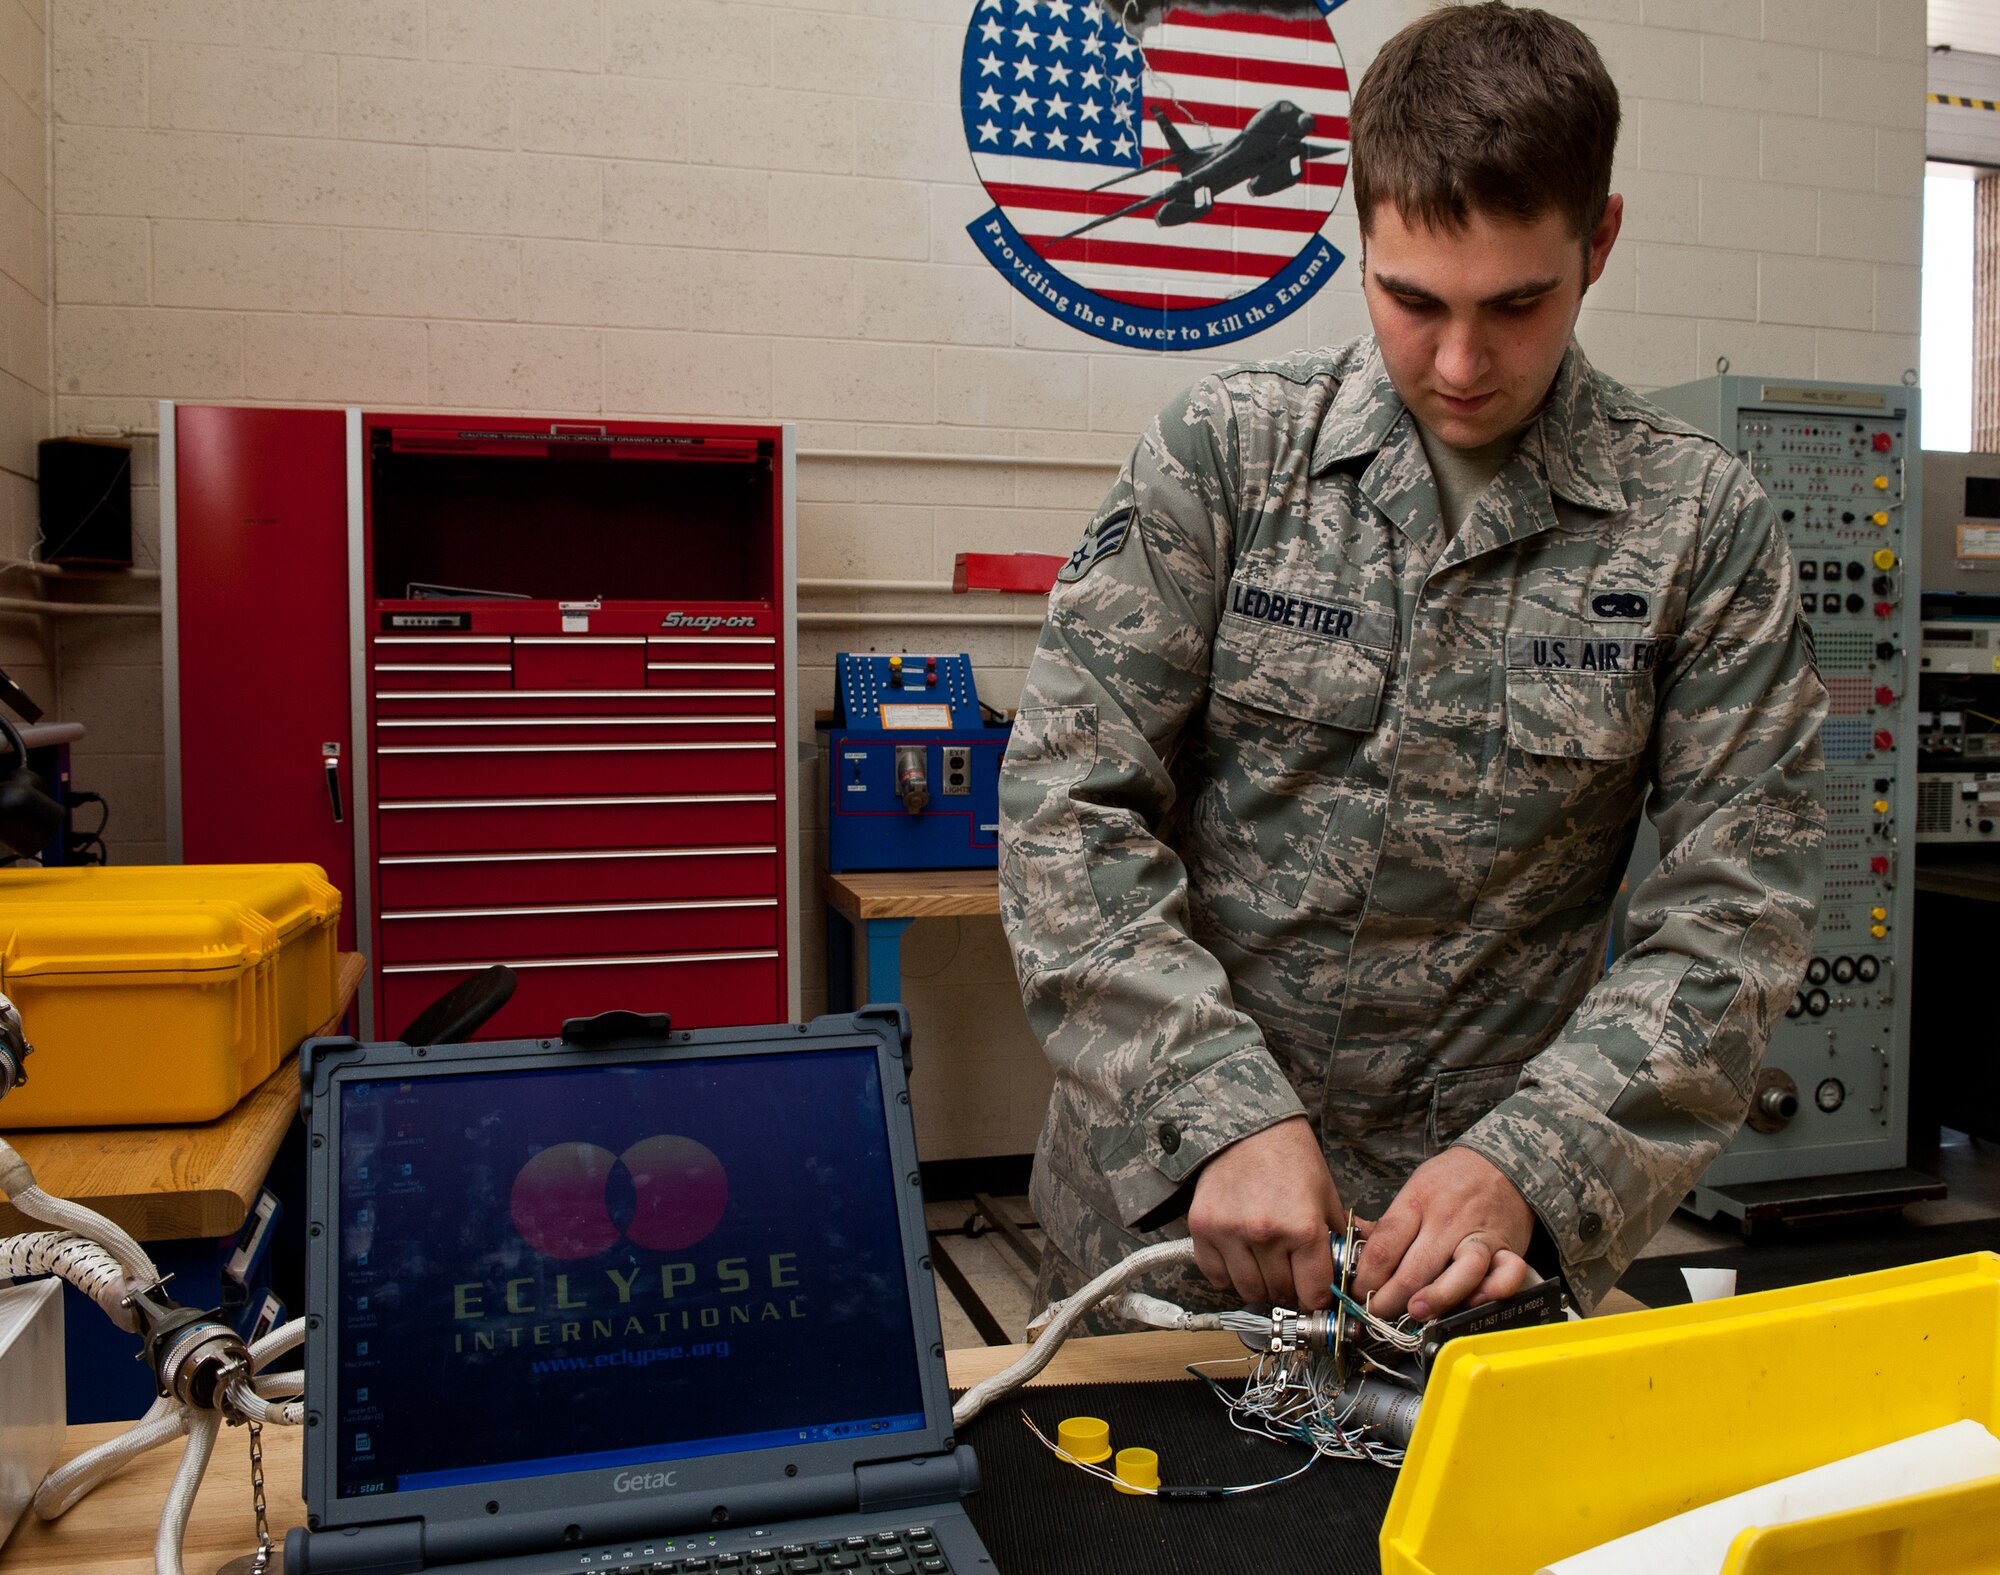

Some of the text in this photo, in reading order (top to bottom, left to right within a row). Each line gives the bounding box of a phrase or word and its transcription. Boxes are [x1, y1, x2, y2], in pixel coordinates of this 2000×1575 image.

[984, 218, 1331, 341] Providing the Power to Kill the Enemy
[1232, 585, 1353, 639] LEDBETTER
[1533, 640, 1571, 669] U.S.
[1581, 642, 1621, 671] AIR
[454, 1252, 800, 1319] ECLYPSE
[454, 1299, 807, 1353] INTERNATIONAL
[1470, 1296, 1544, 1332] FLT INST TEST & MODES
[530, 1341, 730, 1373] www.eclypse.org
[360, 1482, 385, 1493] start
[613, 1471, 677, 1493] Getac
